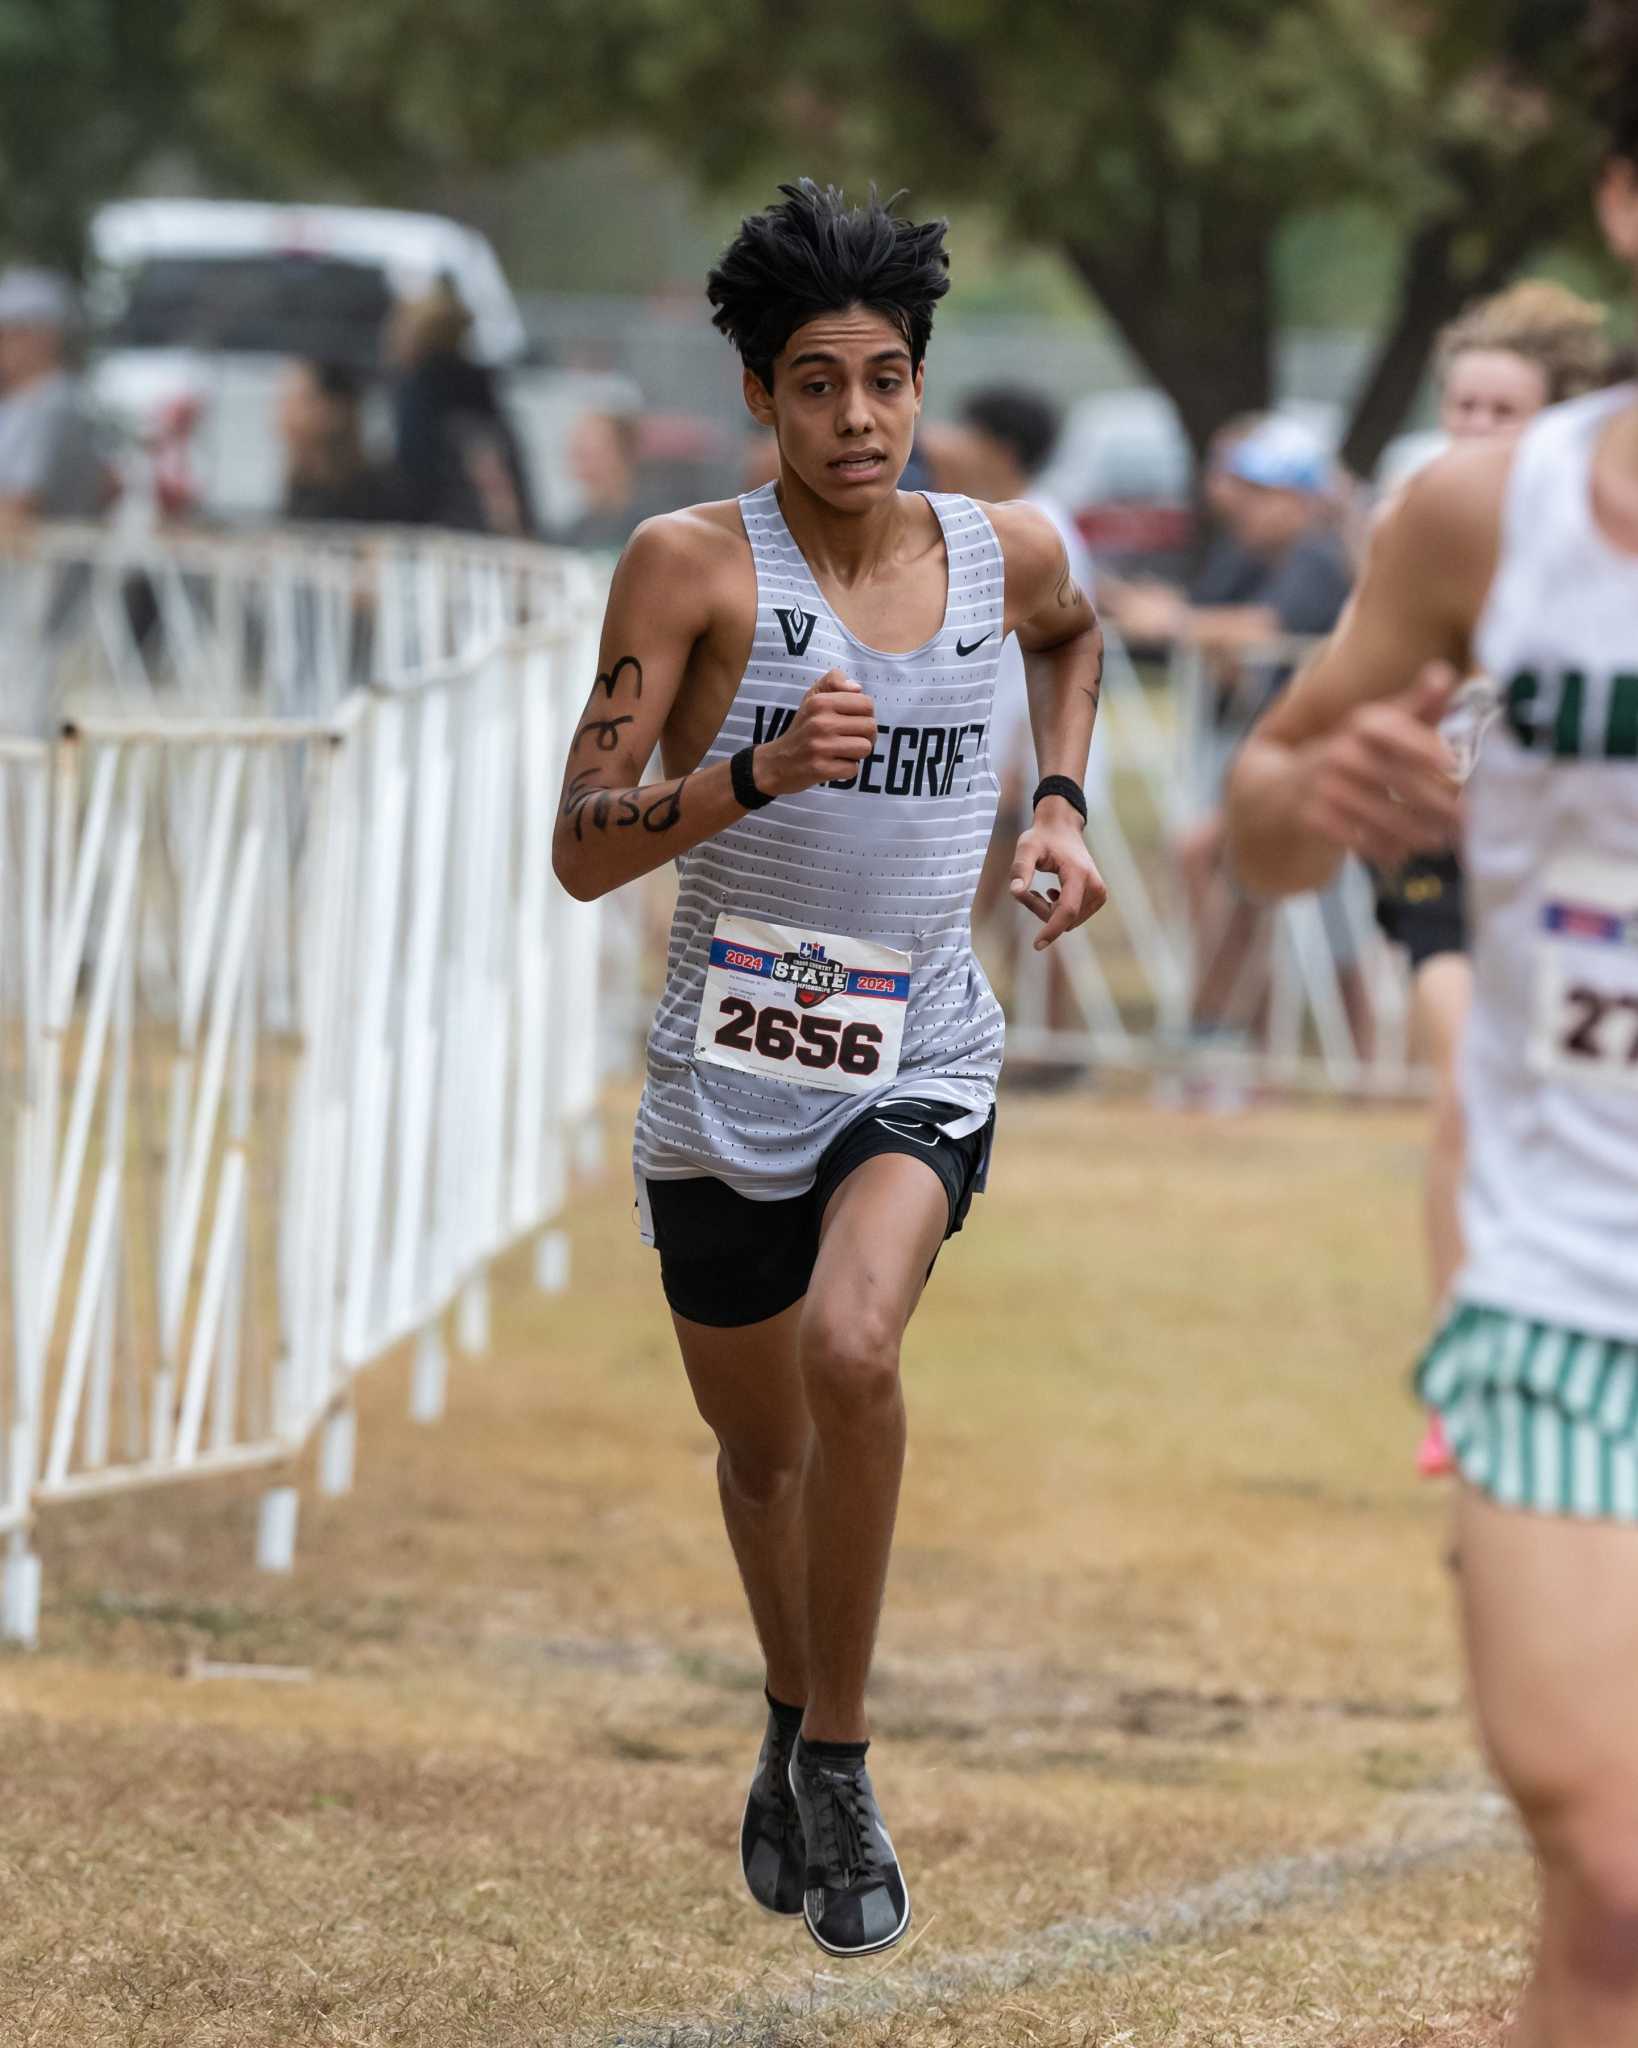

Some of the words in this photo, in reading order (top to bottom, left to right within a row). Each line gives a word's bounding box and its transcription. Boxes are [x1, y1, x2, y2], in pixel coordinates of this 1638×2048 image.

[752, 705, 985, 796] VEGRIFT
[725, 950, 763, 971] 2024
[774, 961, 846, 989] STATE
[857, 976, 896, 992] 2024
[714, 996, 883, 1076] 2656
